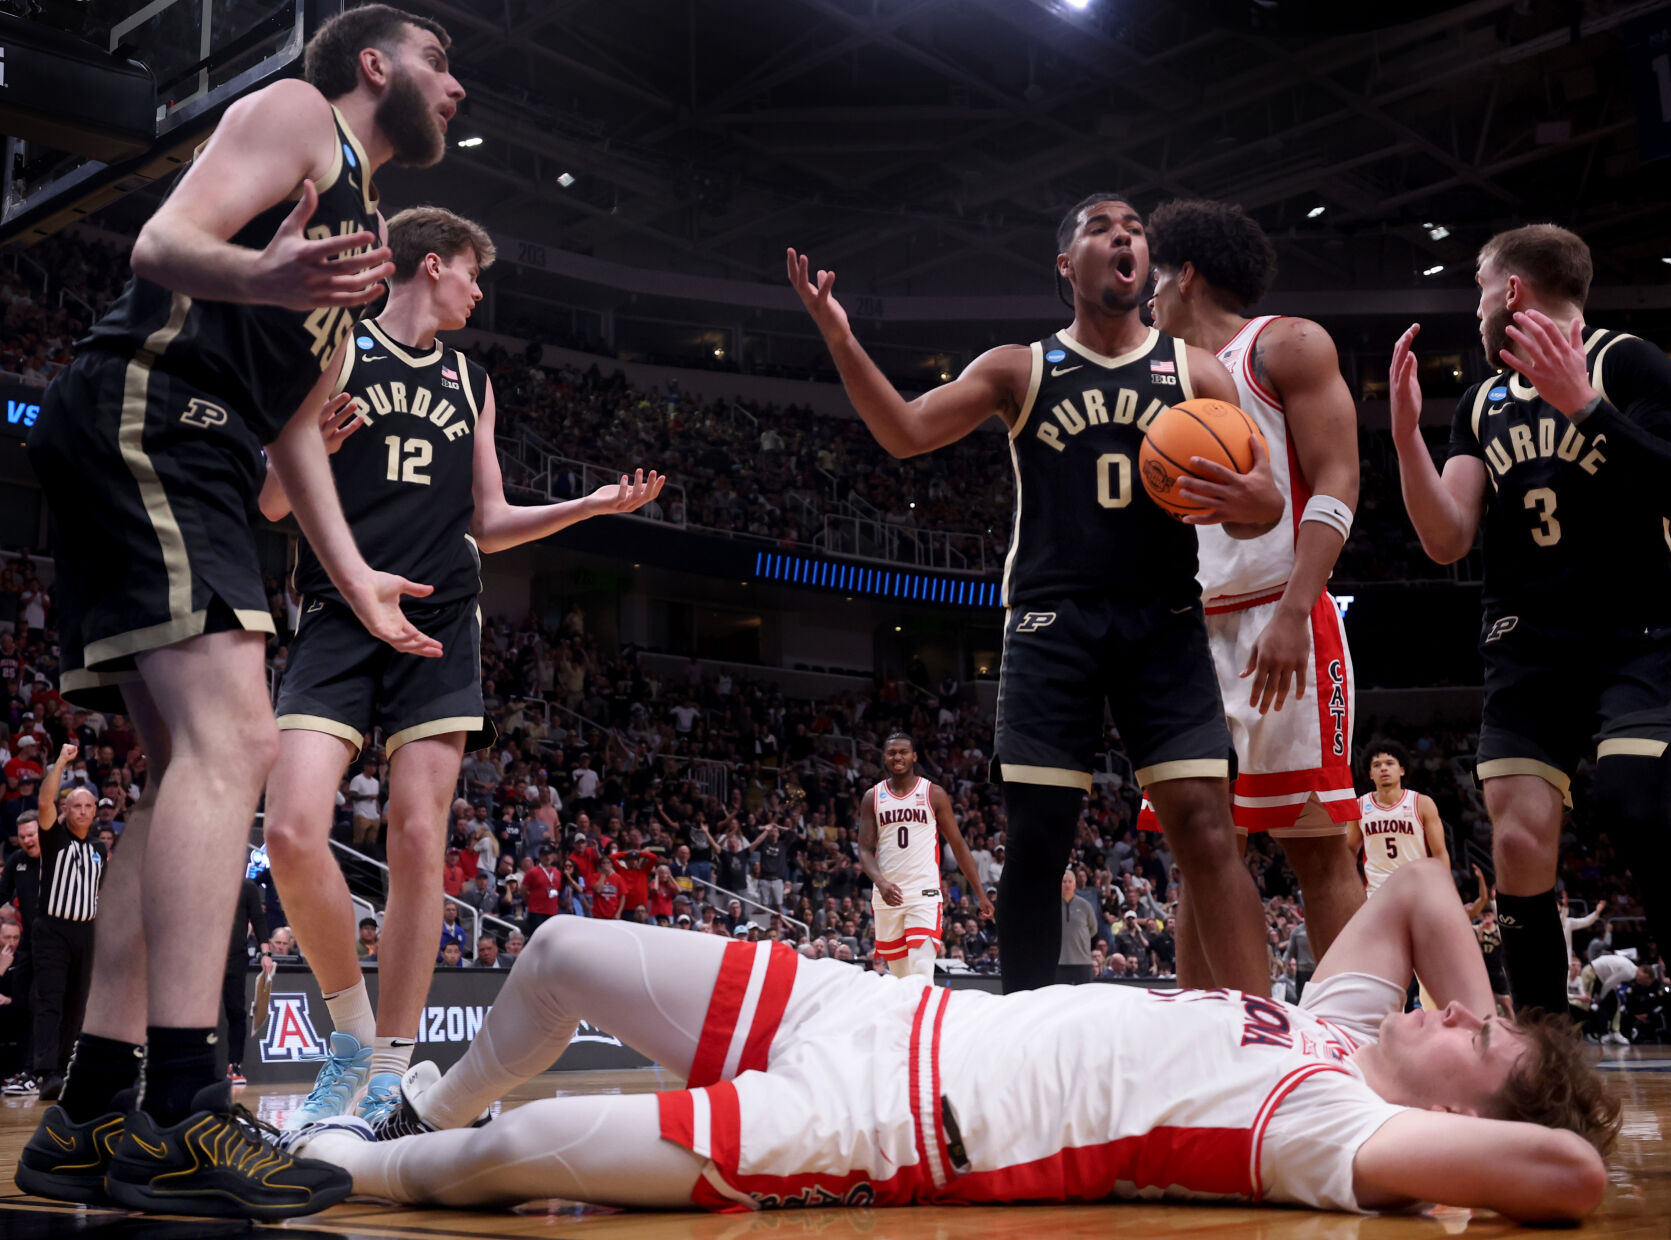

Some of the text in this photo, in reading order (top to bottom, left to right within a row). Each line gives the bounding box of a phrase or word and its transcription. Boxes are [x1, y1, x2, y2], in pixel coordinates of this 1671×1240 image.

[518, 242, 548, 267] 203
[856, 296, 884, 318] 204
[351, 381, 471, 442] PURDUE
[1036, 388, 1170, 452] PURDU
[384, 435, 433, 486] 12
[1485, 418, 1607, 492] URDUE
[1096, 453, 1133, 509] 0
[1523, 487, 1562, 547] 3
[1328, 659, 1346, 756] CATS
[878, 808, 928, 827] ARIZONA
[897, 826, 909, 849] 0
[1364, 820, 1414, 836] ARIZONA
[1384, 837, 1398, 859] 5
[259, 992, 330, 1063] A
[415, 1006, 493, 1043] IZON
